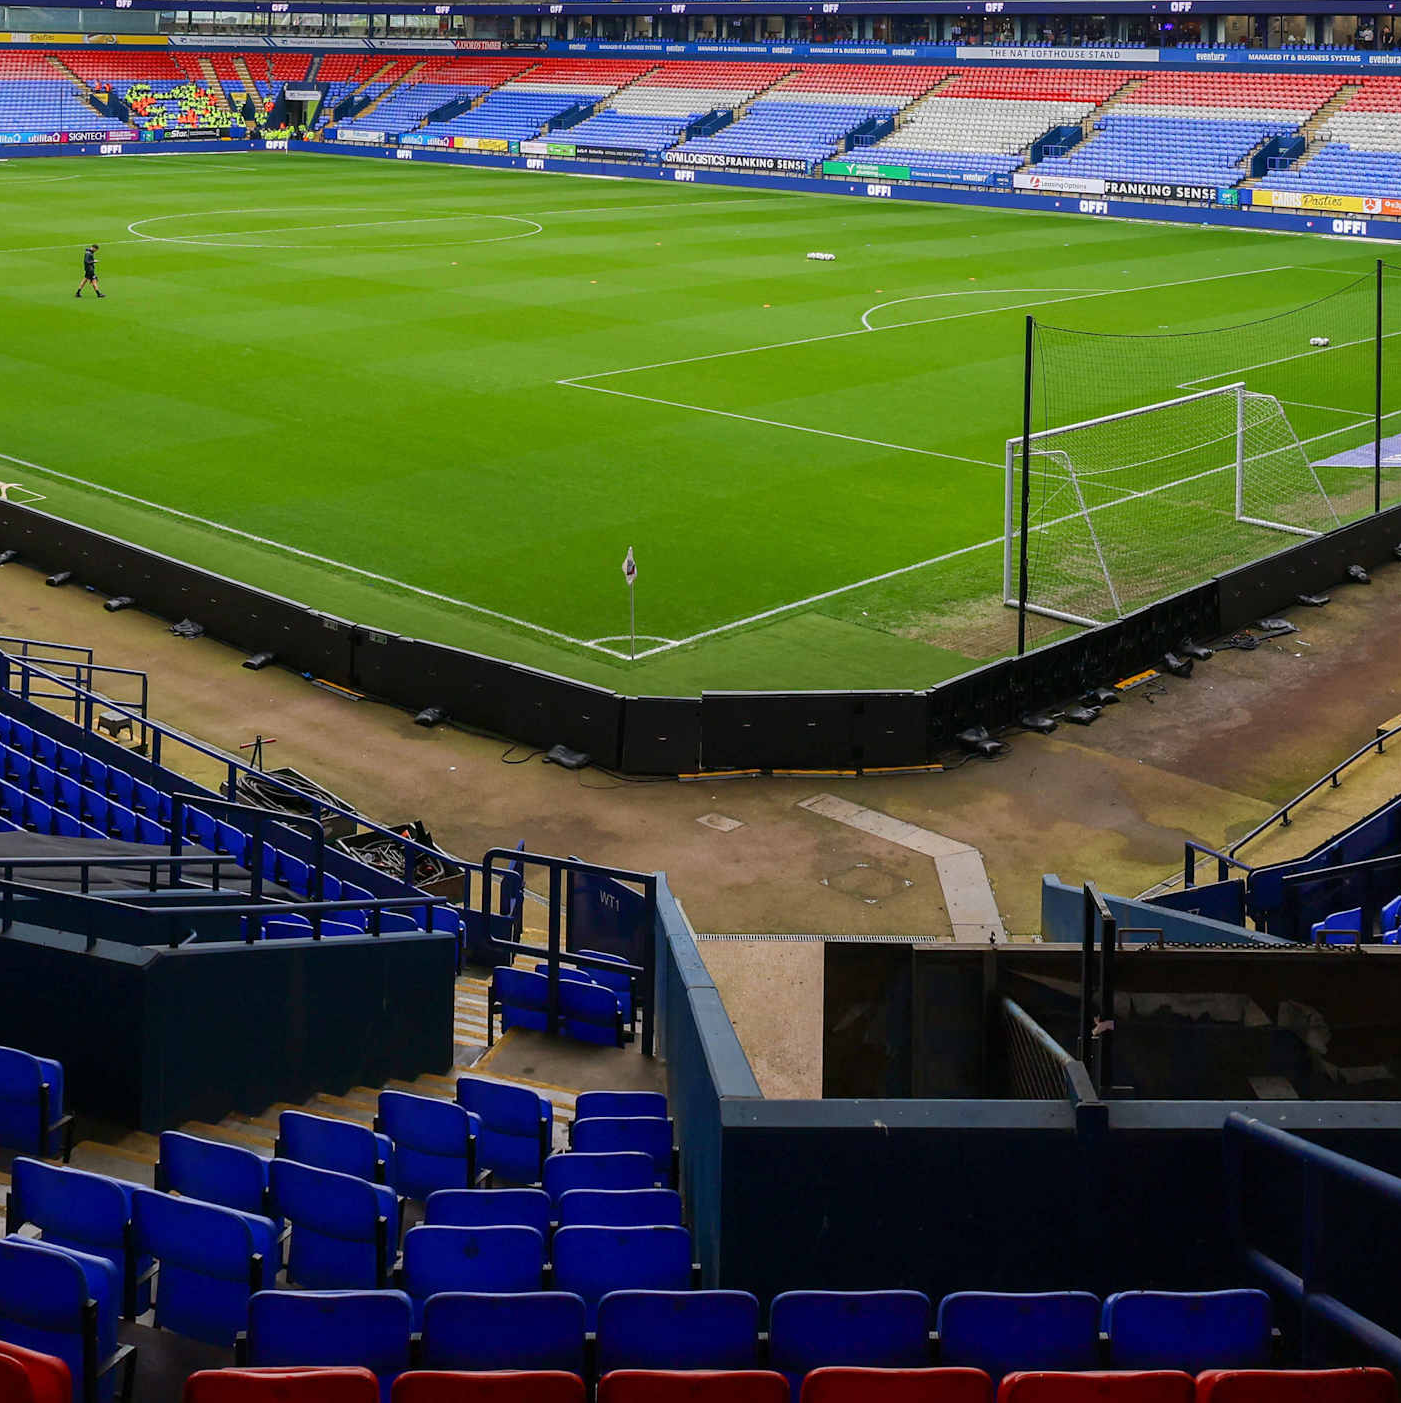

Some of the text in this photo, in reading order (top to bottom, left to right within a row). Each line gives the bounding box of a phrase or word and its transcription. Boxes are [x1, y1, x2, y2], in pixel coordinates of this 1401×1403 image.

[1171, 2, 1192, 13] OFF
[990, 49, 1121, 59] THE NAT LOFTHOUSE STAND
[1330, 55, 1361, 63] SYSTEMS
[69, 132, 106, 142] SIGNTECH
[725, 156, 806, 170] FRANKING SENSE
[1105, 181, 1171, 197] FRANKING
[1177, 187, 1216, 200] SENSE
[1302, 194, 1342, 209] Pasties
[599, 889, 620, 912] WT1
